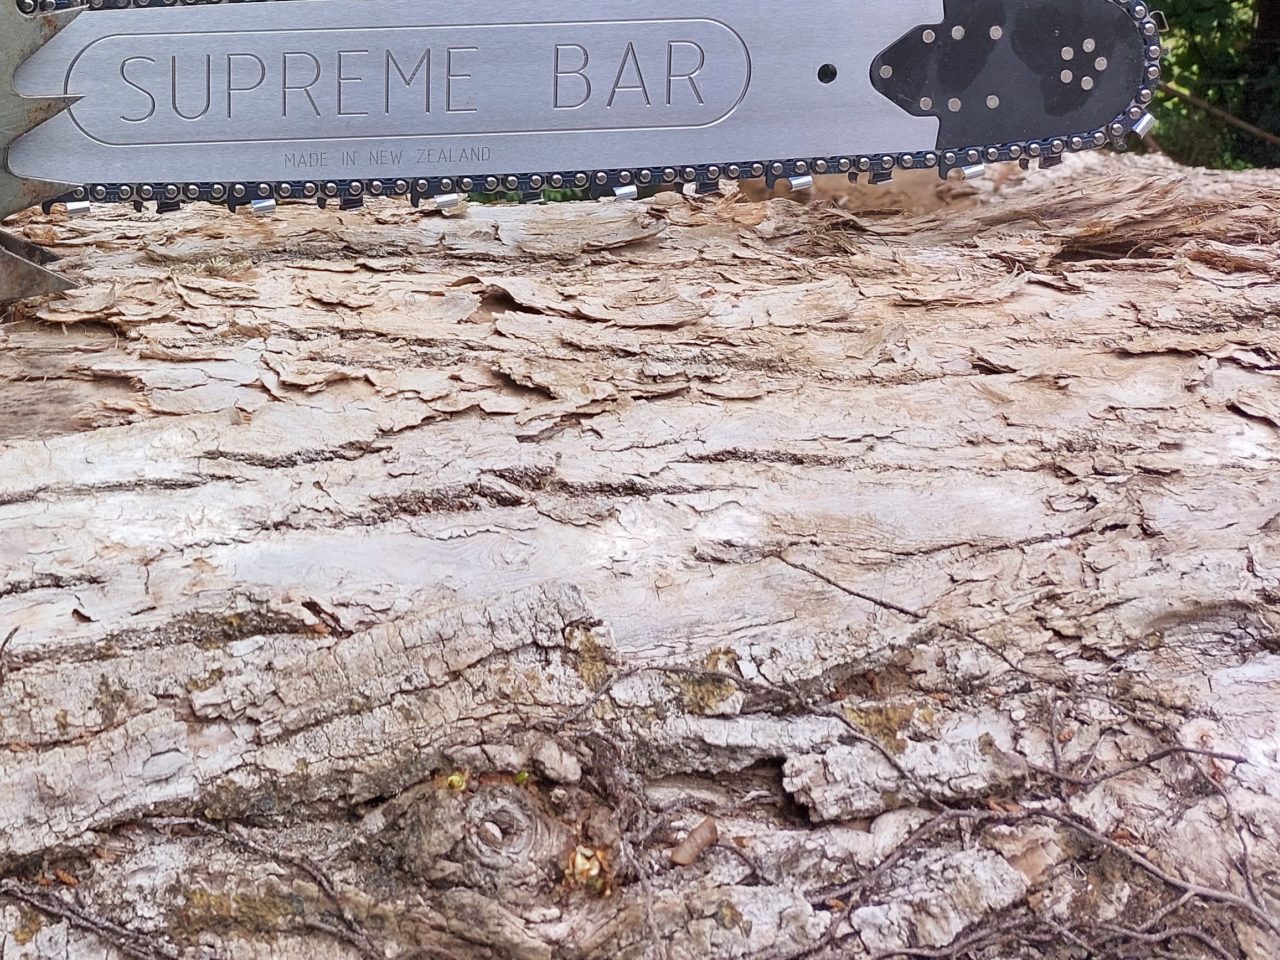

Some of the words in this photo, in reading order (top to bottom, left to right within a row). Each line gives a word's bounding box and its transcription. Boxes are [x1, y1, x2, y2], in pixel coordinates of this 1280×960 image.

[120, 46, 479, 122] SUPREME
[552, 40, 705, 110] BAR
[284, 152, 328, 168] MADE
[341, 151, 358, 167] IN
[369, 149, 404, 165] NEW
[416, 146, 491, 164] ZEALAND
